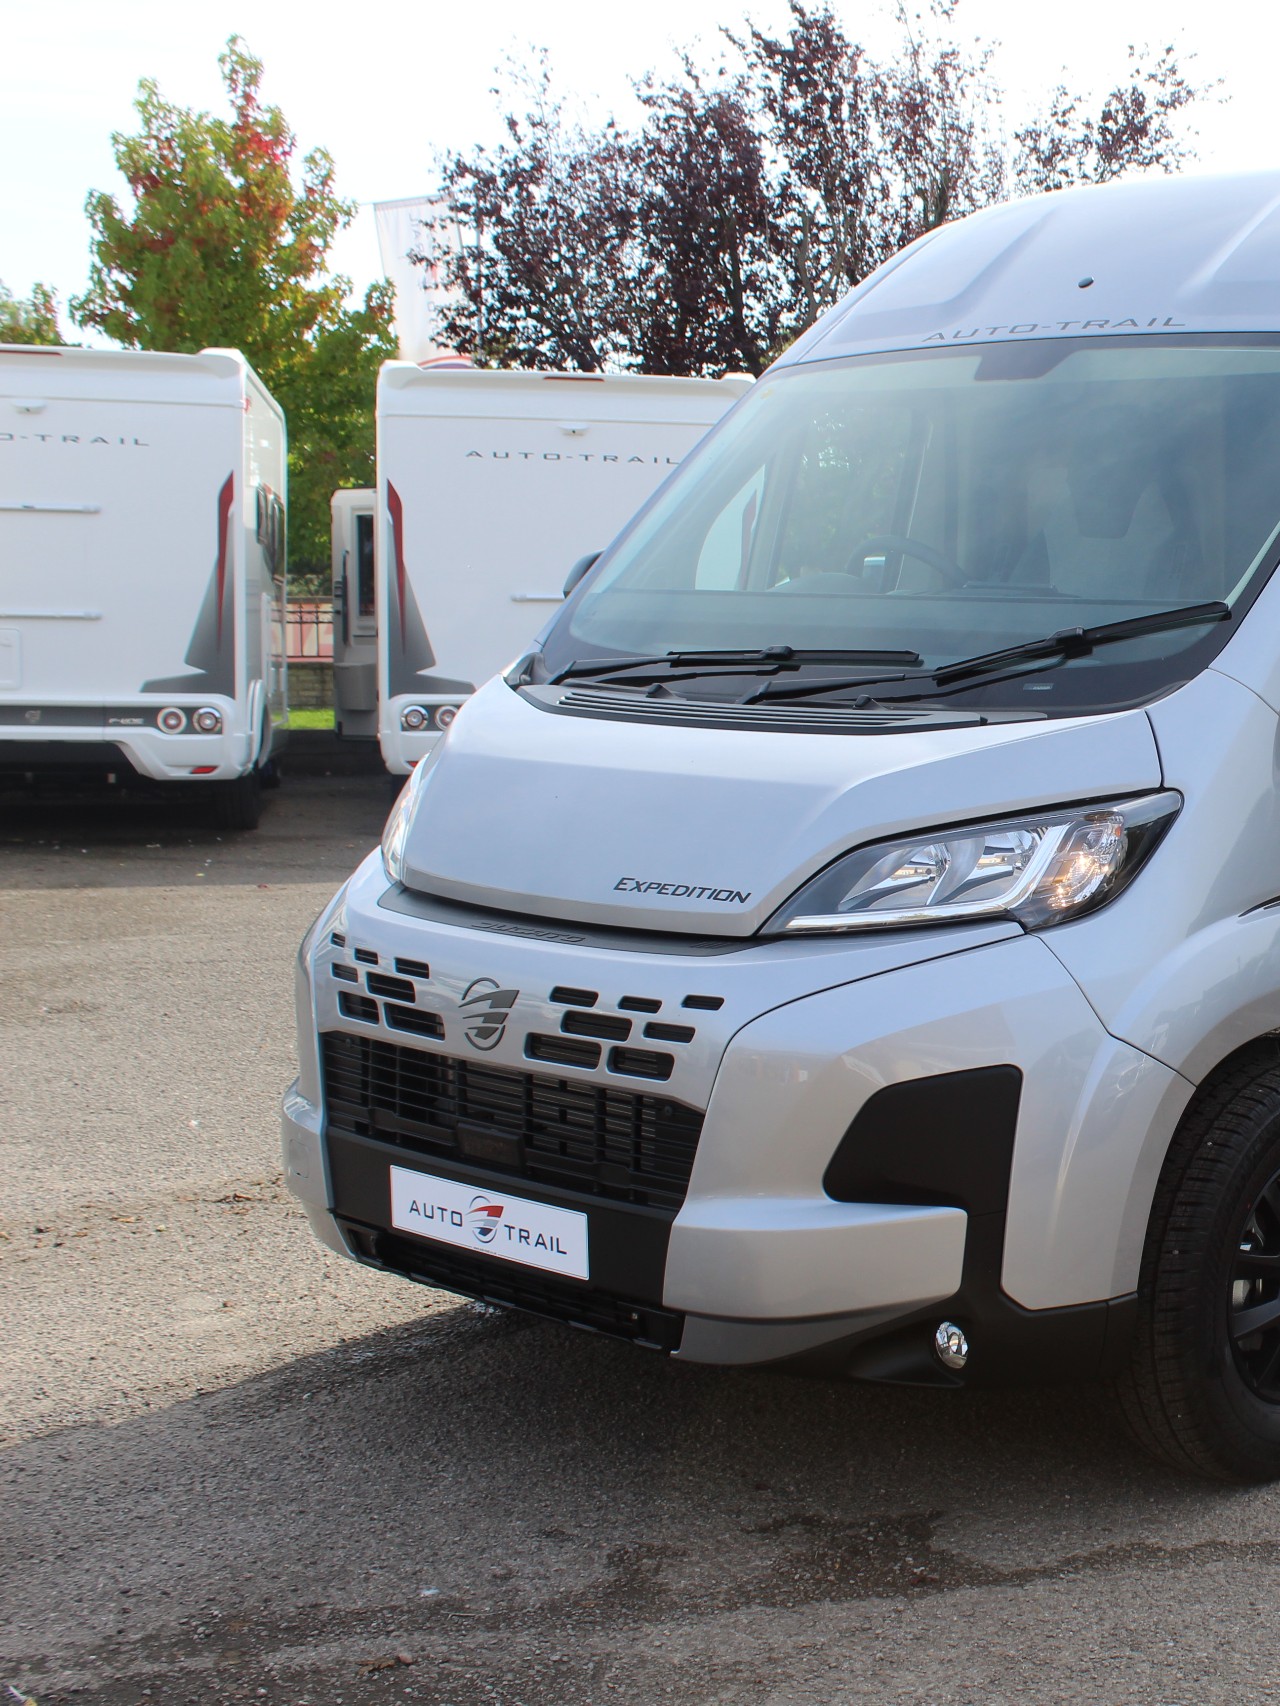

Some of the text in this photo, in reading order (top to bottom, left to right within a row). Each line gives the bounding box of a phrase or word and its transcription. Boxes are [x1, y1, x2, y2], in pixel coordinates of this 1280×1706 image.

[922, 316, 1186, 343] AUTO-TRAIL
[465, 450, 680, 465] AUTO-TRAIL
[613, 877, 752, 904] EXPEDITION
[409, 1200, 567, 1255] AUTO TRAIL
